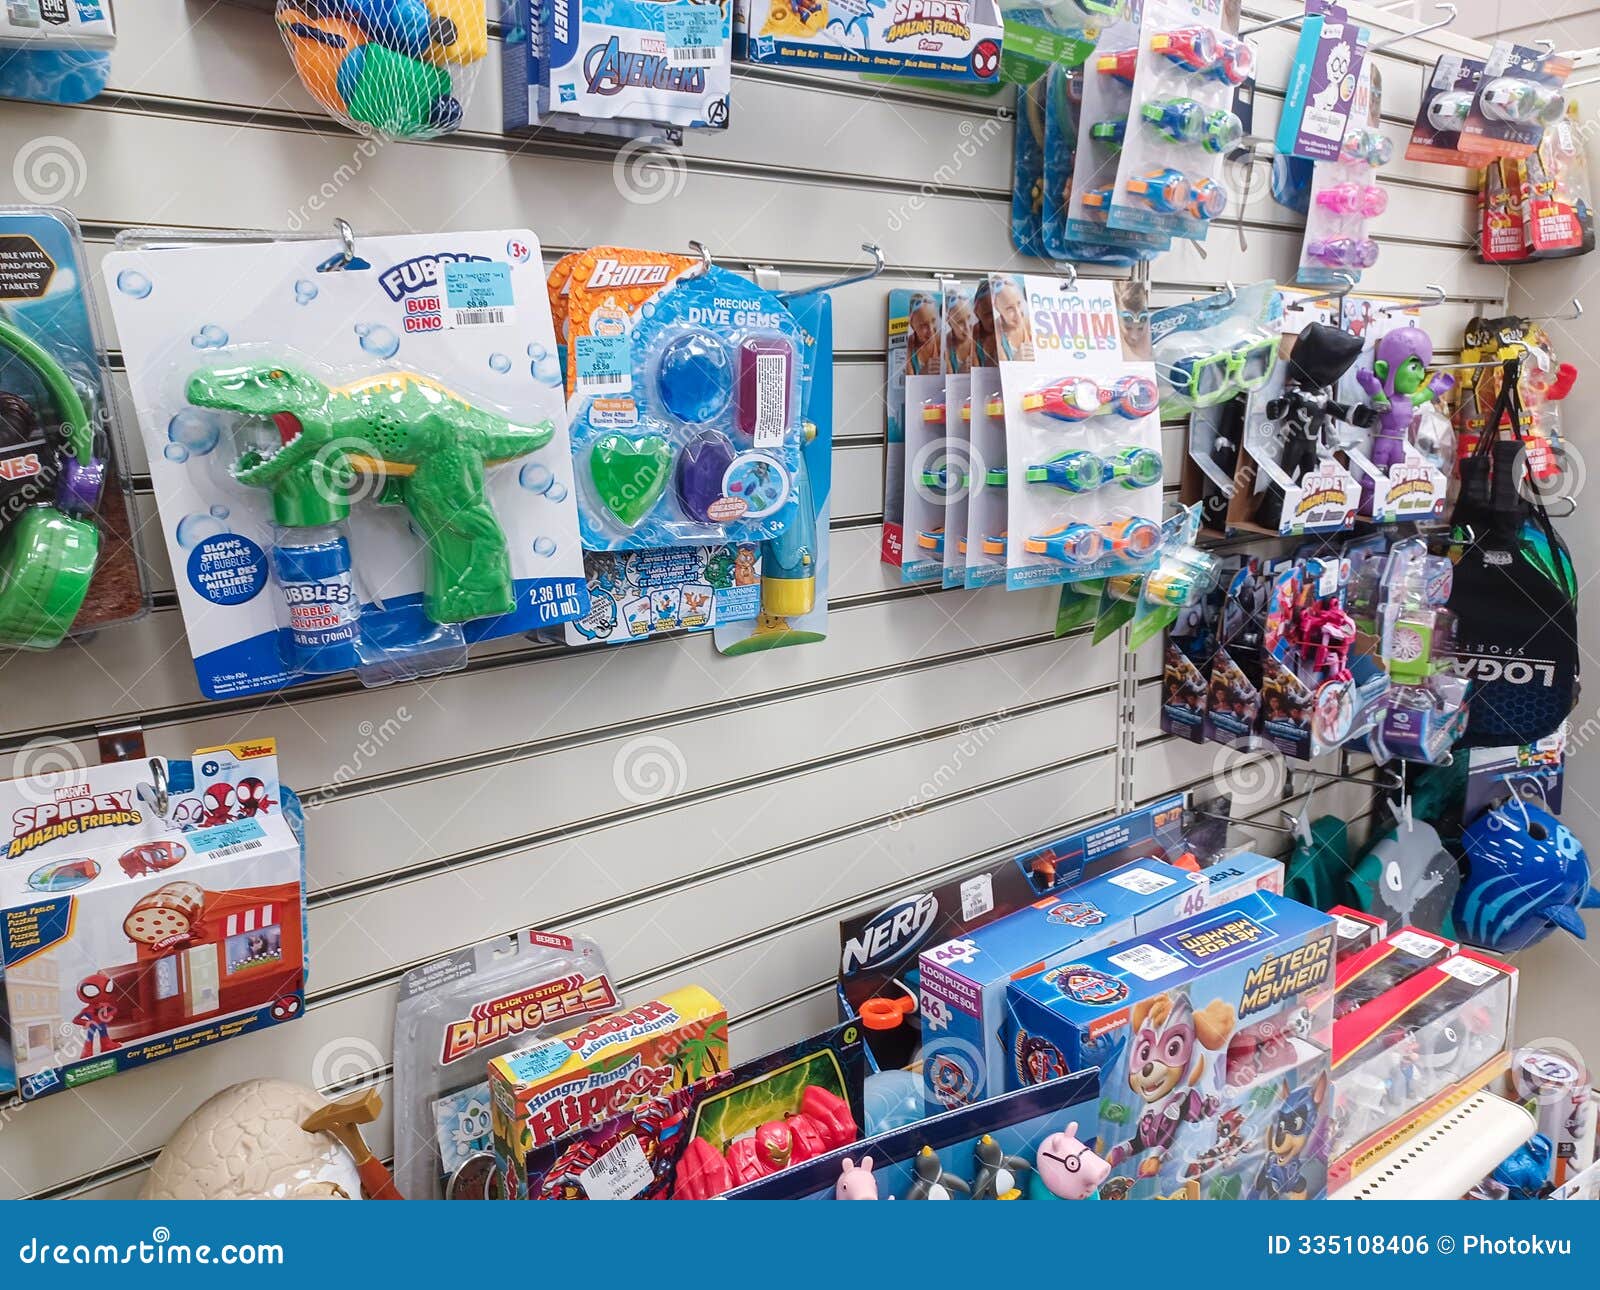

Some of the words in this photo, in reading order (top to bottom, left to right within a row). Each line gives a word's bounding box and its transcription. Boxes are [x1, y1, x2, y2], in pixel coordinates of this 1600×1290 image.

[894, 0, 969, 24] SPIDEY
[886, 20, 932, 41] AMAZING
[933, 19, 971, 40] FRIENDS
[641, 38, 666, 53] MARVE
[584, 36, 706, 95] AVENGERS
[512, 242, 528, 258] 3+
[0, 272, 41, 281] TPHONES
[713, 298, 761, 311] PRECIOUS
[688, 308, 731, 326] DIVE
[733, 311, 780, 329] GEMS
[1034, 310, 1117, 340] SWIM
[1036, 335, 1118, 350] GOGGLES
[201, 547, 251, 563] STREAMS
[203, 540, 241, 554] BLOWS
[199, 570, 235, 583] FAITES
[238, 565, 258, 577] DES
[200, 562, 212, 572] OF
[214, 557, 252, 570] BUBBLES
[206, 575, 254, 590] MILLIERS
[209, 589, 221, 599] DE
[223, 584, 255, 597] BULLES
[530, 585, 554, 605] 2.36
[565, 583, 578, 597] oz
[540, 601, 559, 622] (70
[560, 597, 580, 616] mL)
[321, 628, 353, 644] (70mL)
[55, 784, 90, 800] MARVEL
[13, 789, 133, 837] SPIDEY
[9, 815, 78, 858] AMAZING
[80, 810, 142, 832] FRIENDS
[1182, 889, 1204, 916] 46
[842, 892, 935, 973] NERF
[935, 945, 967, 962] 46
[1245, 936, 1332, 990] METEOR
[920, 962, 945, 983] FLOOR
[944, 974, 977, 998] PUZZLE
[493, 996, 523, 1012] FLICK
[523, 991, 535, 1000] TO
[535, 984, 565, 998] STICK
[919, 977, 948, 998] PUZZLE
[949, 990, 960, 1004] DE
[960, 995, 977, 1012] SOL
[920, 995, 941, 1017] 46
[446, 976, 614, 1061] BUNGEES
[527, 1079, 588, 1113] Hungry
[588, 1055, 641, 1088] Hungry
[528, 1065, 673, 1148] Hippos
